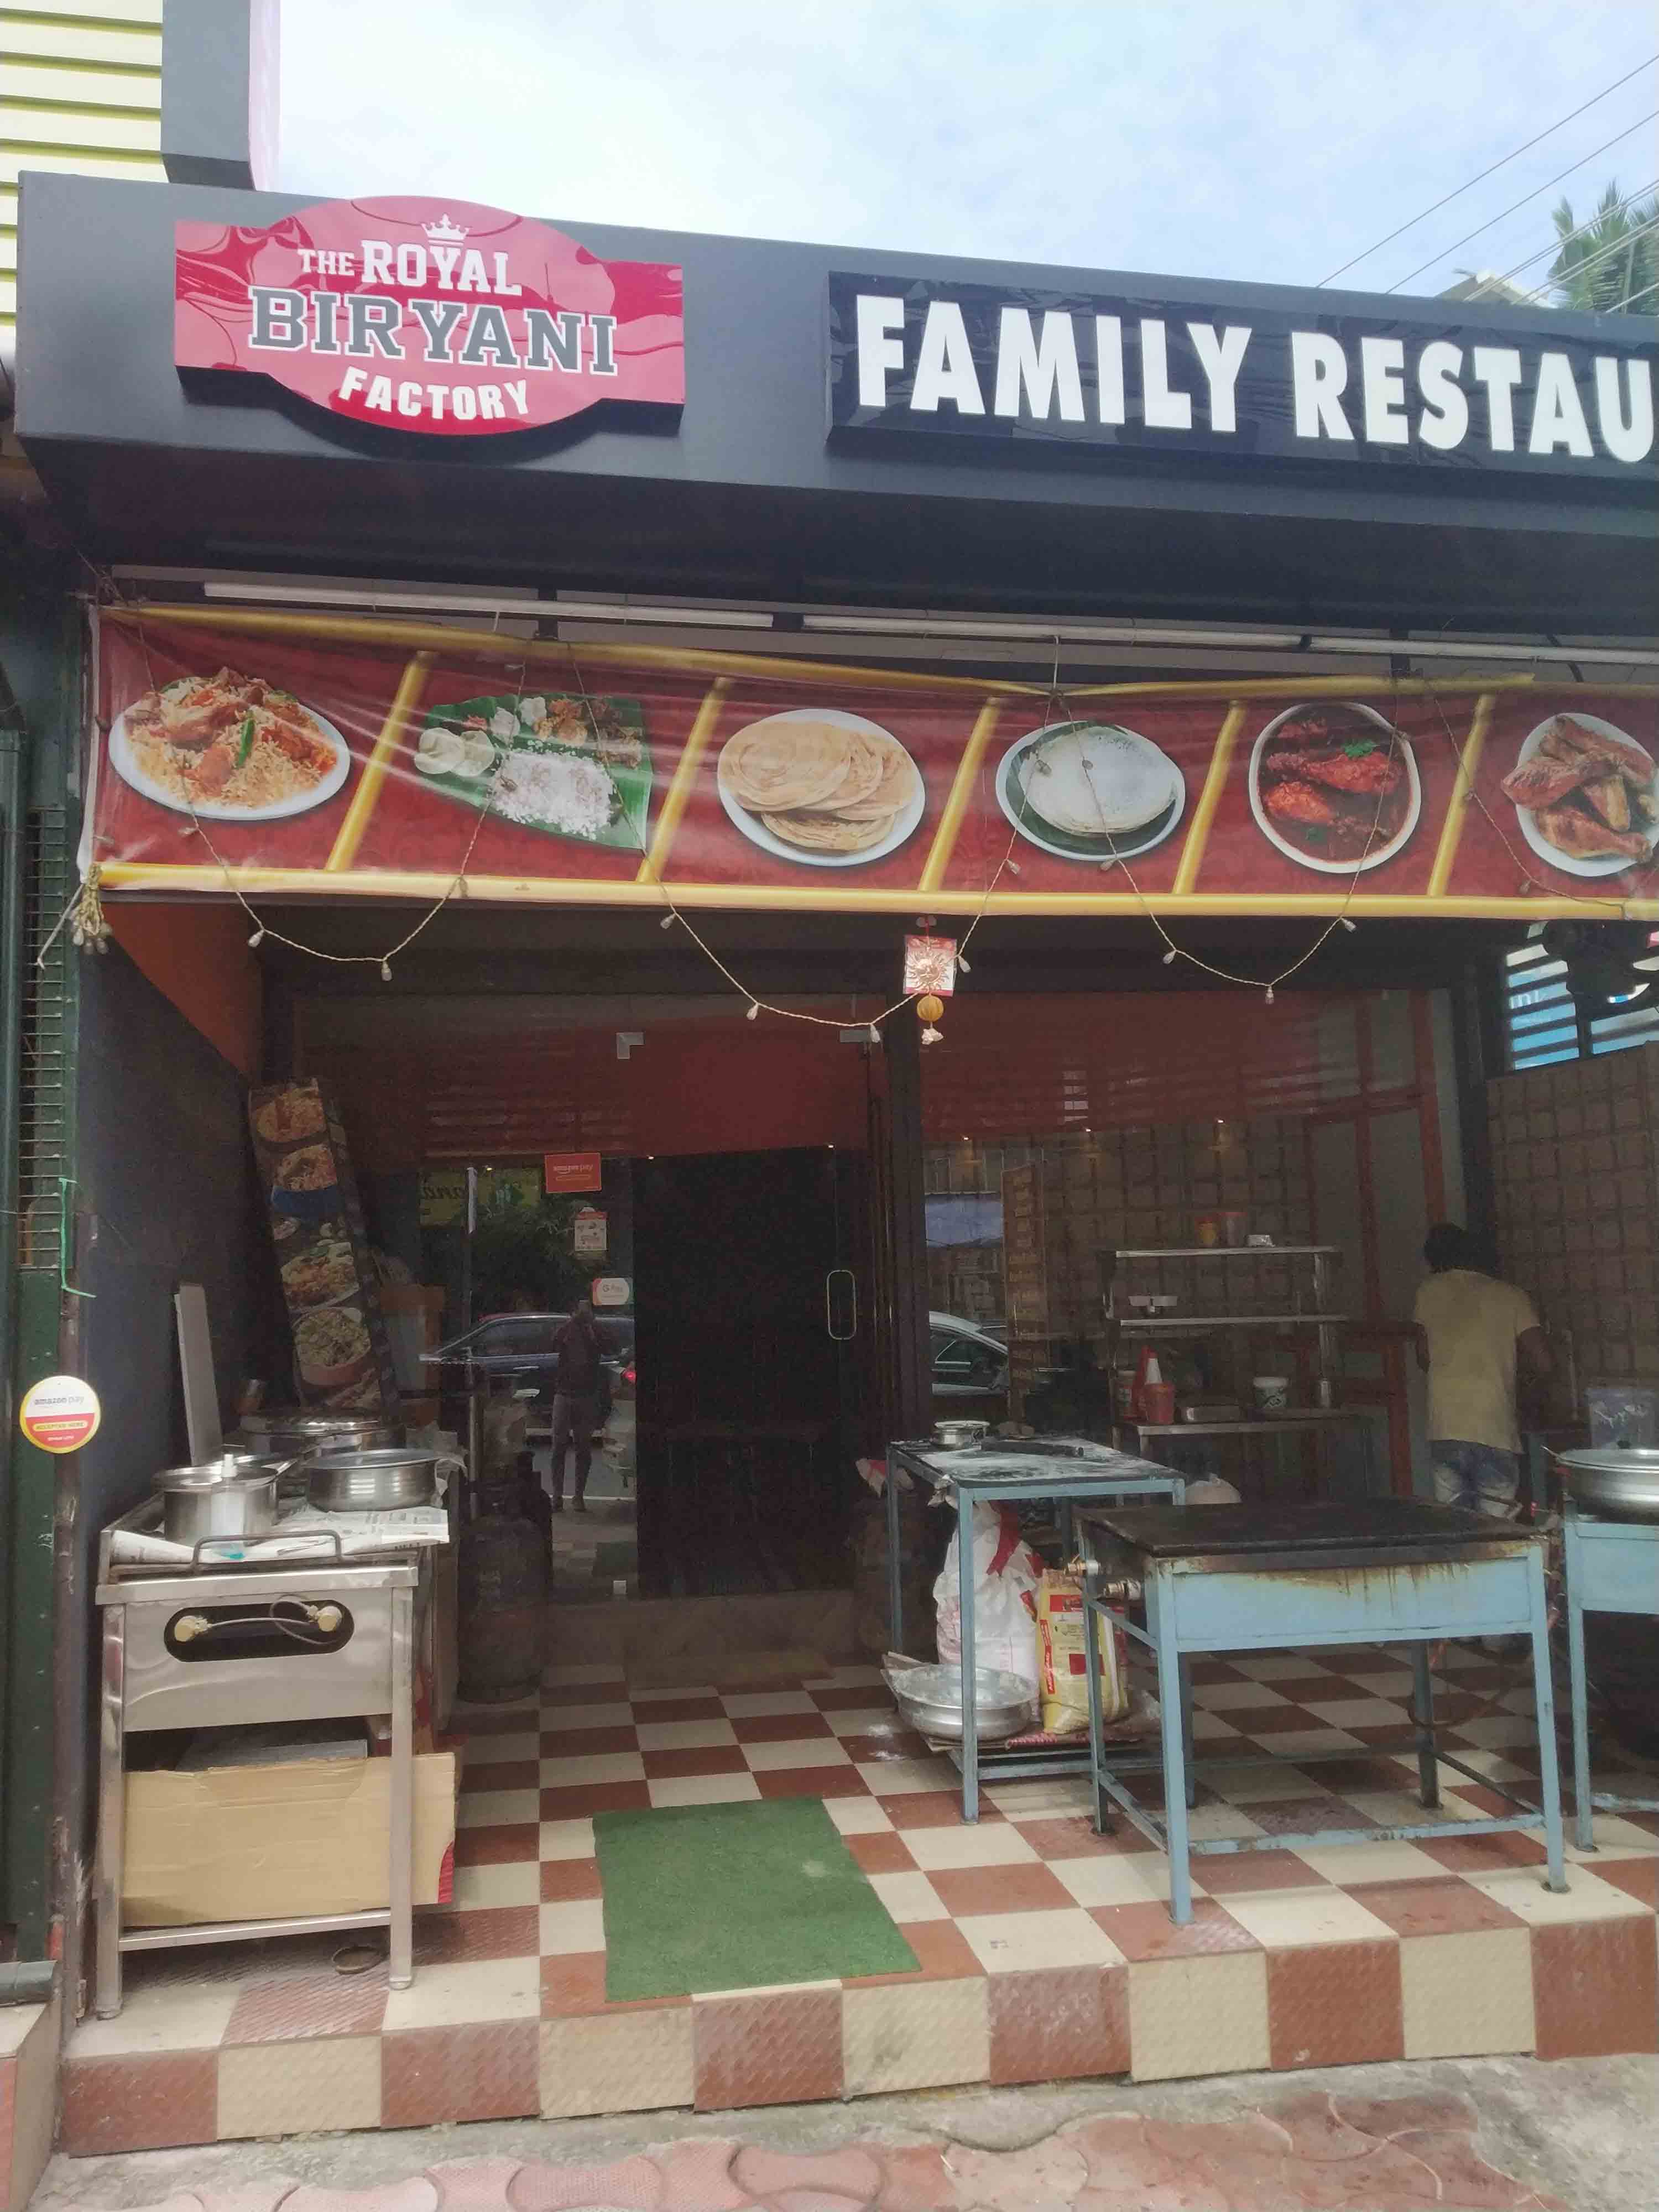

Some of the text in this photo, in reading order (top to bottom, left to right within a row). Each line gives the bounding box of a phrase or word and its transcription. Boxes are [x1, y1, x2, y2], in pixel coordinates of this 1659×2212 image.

[298, 240, 523, 296] THE ROYAL
[248, 285, 618, 376] BIRYANI
[338, 367, 529, 420] FACTORY
[856, 294, 1654, 462] FAMILY RESTAU
[34, 1397, 67, 1405] amazon
